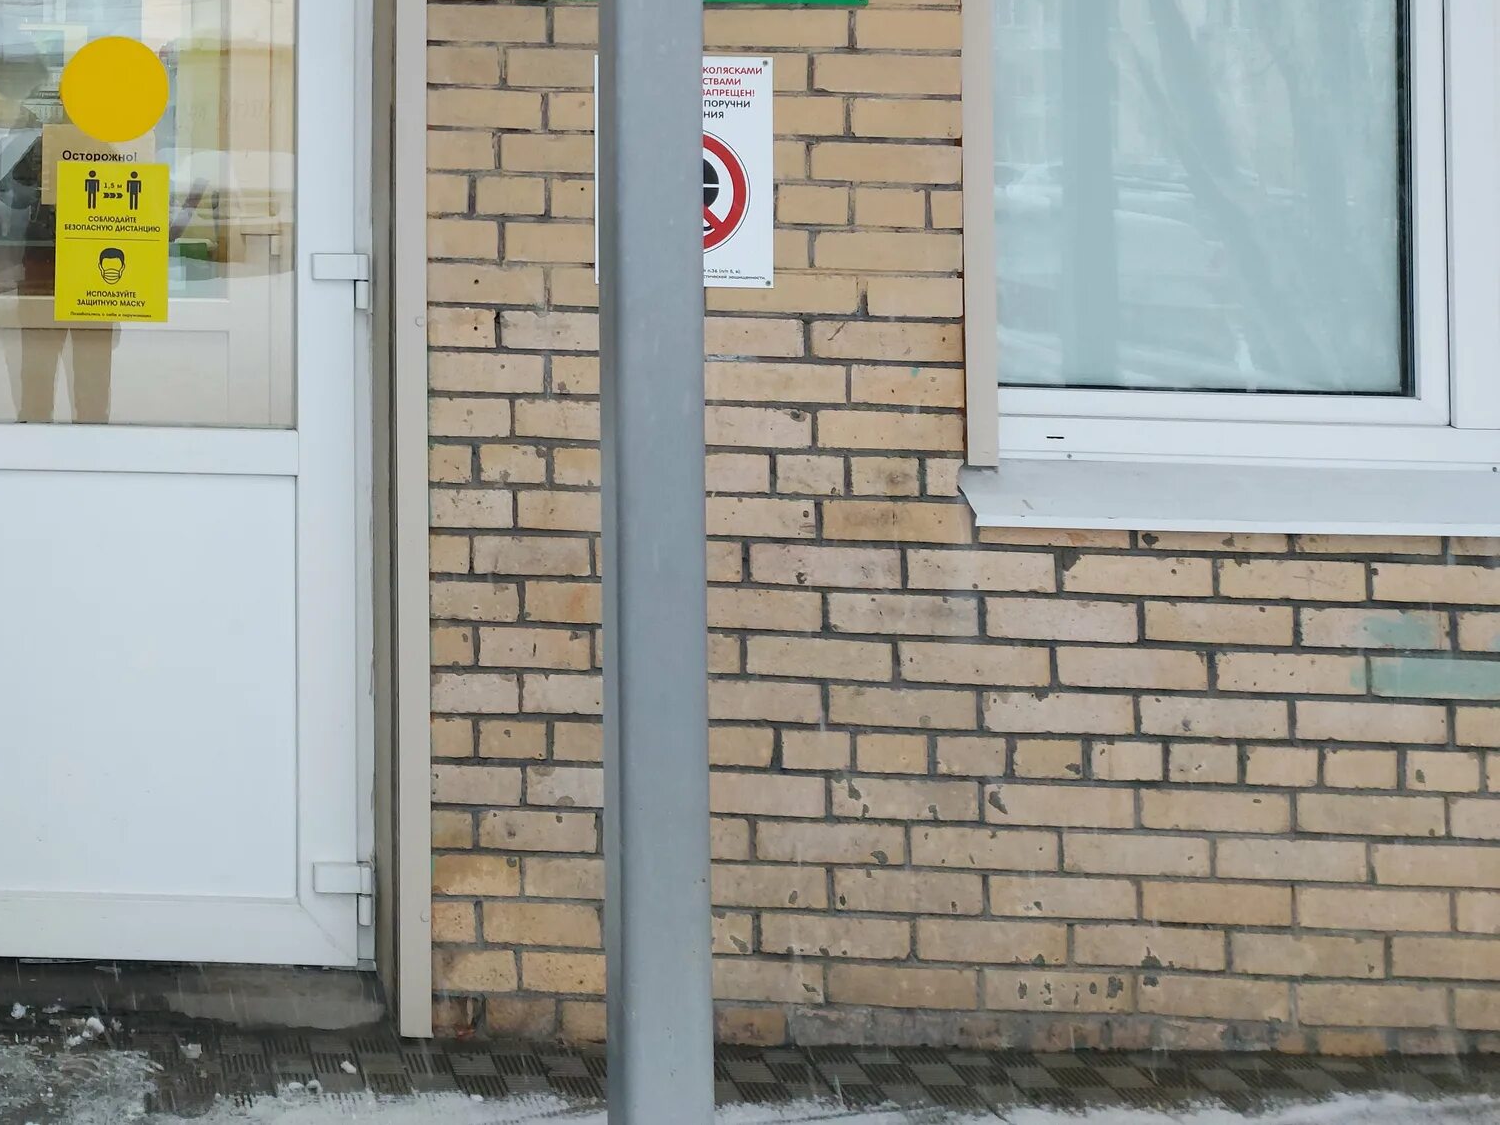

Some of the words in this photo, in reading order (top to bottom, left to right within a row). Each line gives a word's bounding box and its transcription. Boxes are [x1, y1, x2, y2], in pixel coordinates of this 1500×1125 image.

[704, 100, 750, 109] ПОРУЧНИ
[62, 150, 137, 162] Осторожно!
[88, 215, 136, 223] СОБЛЮДАЙТЕ
[115, 225, 160, 233] ДИСТАНЦИЮ
[86, 290, 136, 298] ИСПОЛЬЗУЙТЕ
